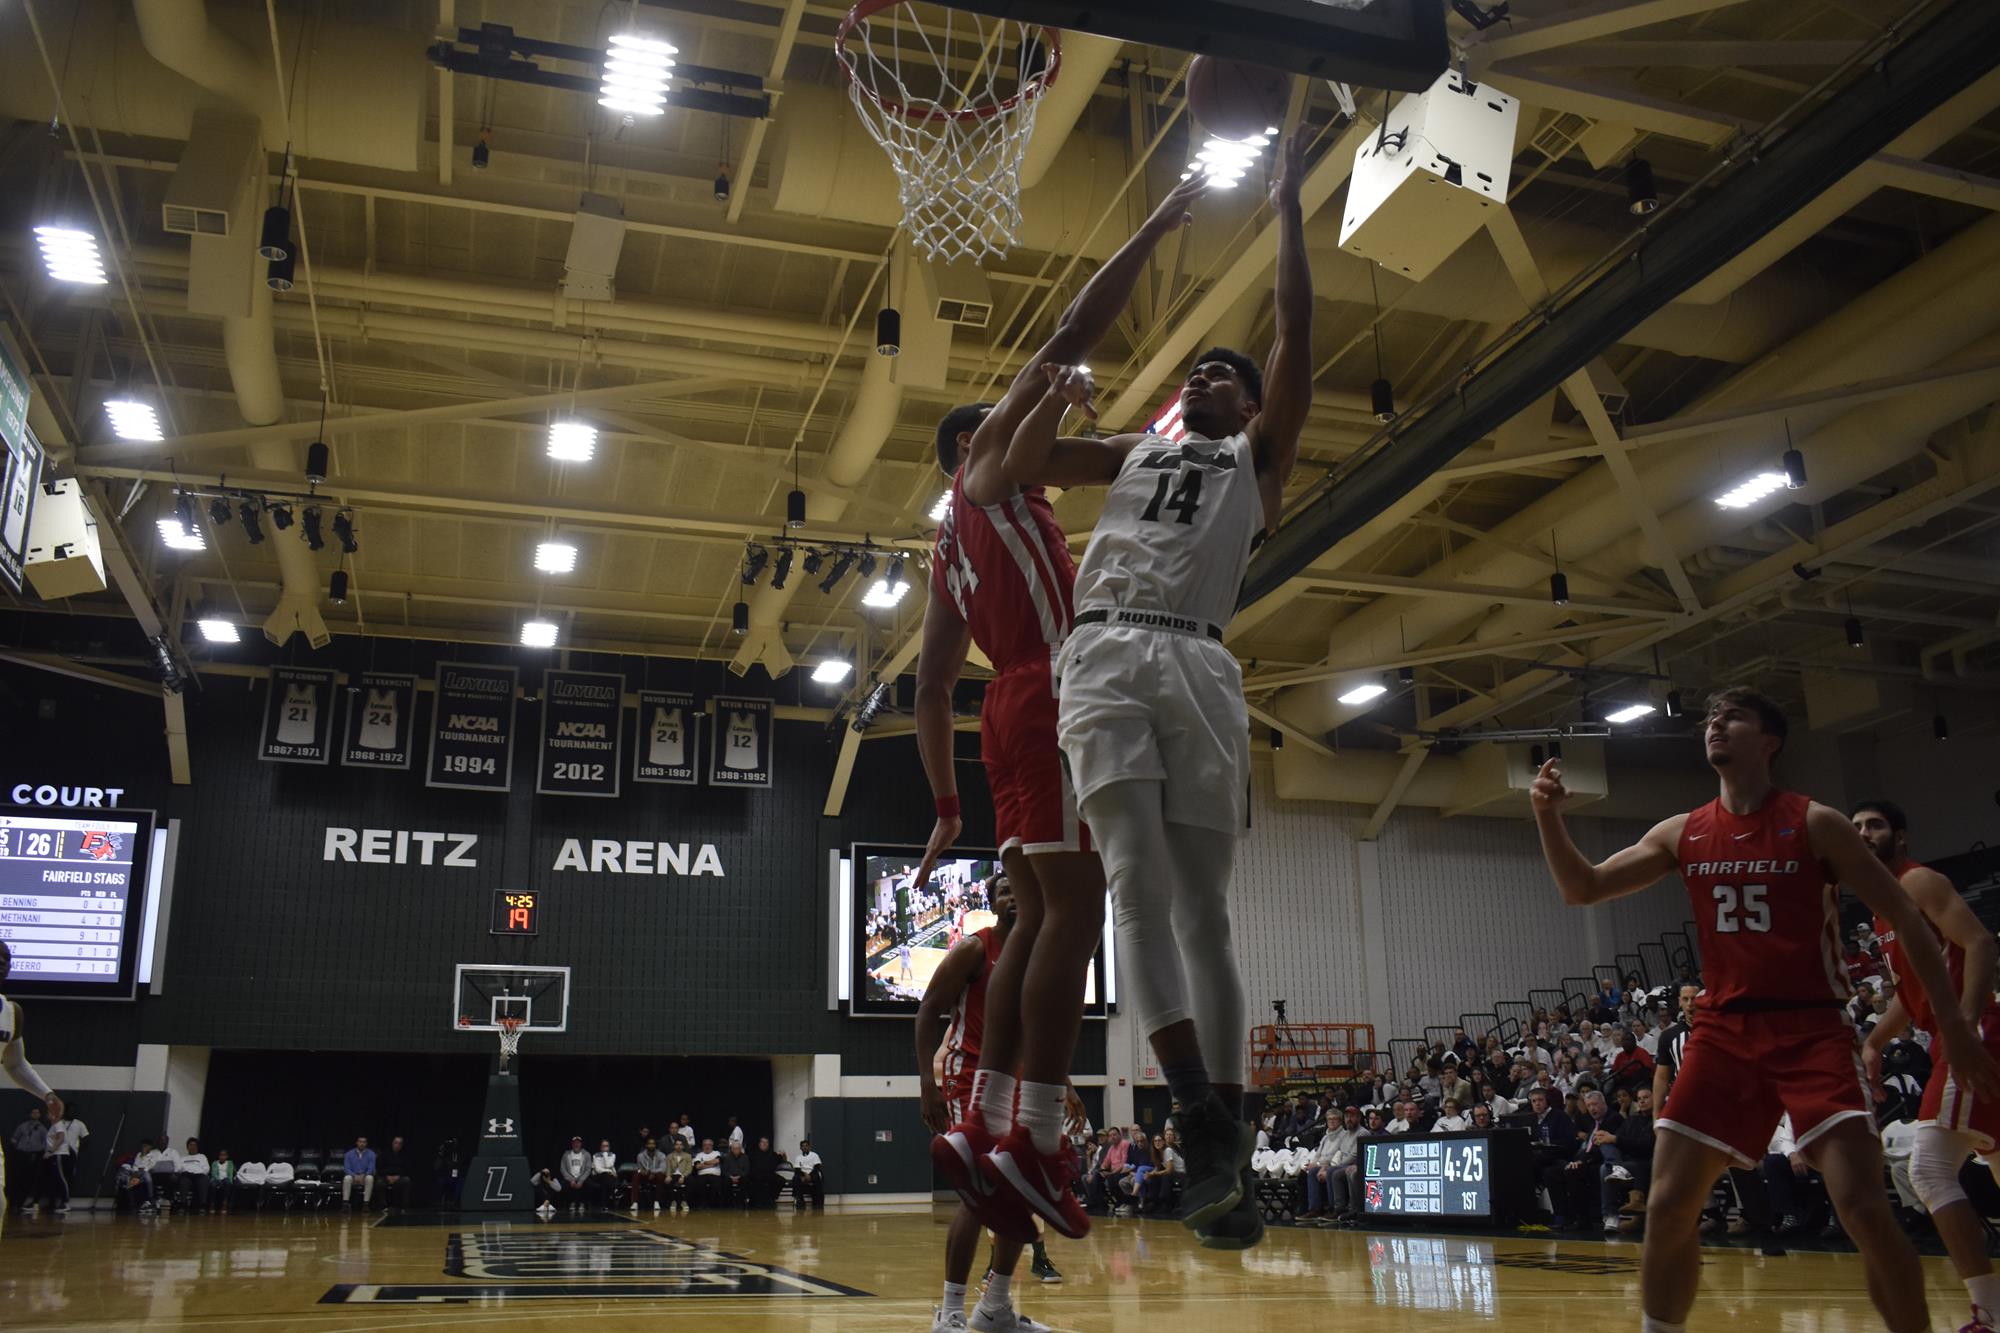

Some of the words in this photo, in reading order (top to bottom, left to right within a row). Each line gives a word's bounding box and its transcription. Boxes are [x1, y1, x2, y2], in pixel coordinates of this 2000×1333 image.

[1140, 470, 1203, 524] 14
[1118, 611, 1198, 632] HOUNDS
[444, 672, 510, 694] LOYOLA
[552, 679, 616, 700] LOYOLA
[288, 707, 308, 722] 21
[368, 712, 392, 726] 24
[448, 714, 498, 732] NCAA
[439, 730, 506, 744] TOURNAMENT
[557, 722, 606, 738] NCAA
[656, 730, 678, 744] 24
[549, 738, 614, 750] TOURNAMENT
[733, 734, 751, 748] 12
[268, 745, 320, 757] 1967-1971
[350, 751, 404, 762] 1968-1972
[443, 754, 496, 774] 1994
[553, 762, 604, 781] 2012
[12, 784, 124, 808] COURT
[27, 833, 51, 856] 26
[323, 827, 478, 868] REITZ
[552, 838, 725, 876] ARENA
[1686, 860, 1800, 877] FAIRFIELD
[43, 870, 92, 884] FAIRFIELD
[94, 872, 126, 885] STAGS
[2, 898, 38, 908] BENNING
[506, 895, 533, 908] 4:25
[1712, 884, 1772, 934] 25
[0, 913, 41, 923] METHNANI
[96, 916, 101, 925] 2
[510, 908, 528, 930] 19
[80, 932, 84, 940] 9
[1409, 1145, 1424, 1156] FOULS
[1388, 1148, 1401, 1172] 23
[1444, 1146, 1483, 1182] 4:25
[483, 1166, 512, 1202] L
[1409, 1182, 1424, 1194] FOULS
[1388, 1186, 1402, 1210] 26
[1462, 1192, 1478, 1210] 1ST
